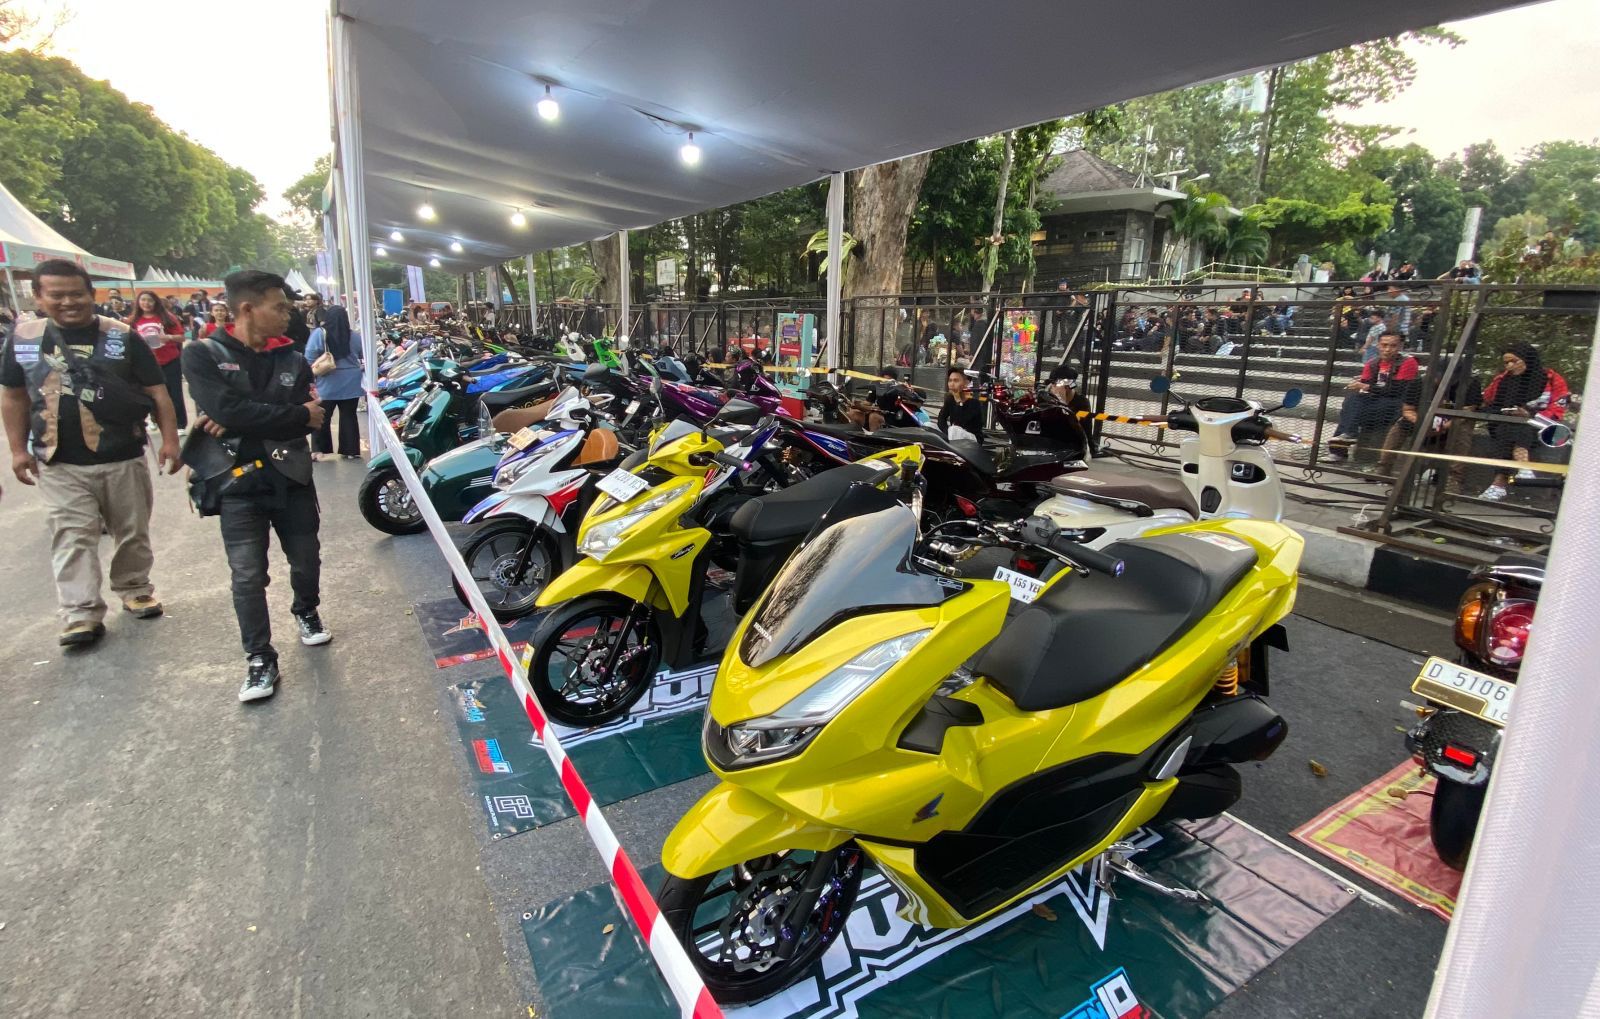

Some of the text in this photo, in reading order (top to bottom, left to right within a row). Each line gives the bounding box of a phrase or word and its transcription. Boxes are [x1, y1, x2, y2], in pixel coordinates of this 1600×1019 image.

[996, 570, 1003, 579] D
[1013, 577, 1027, 588] 155
[754, 621, 773, 643] HONDA
[1428, 663, 1442, 678] D
[1453, 672, 1509, 700] 5106
